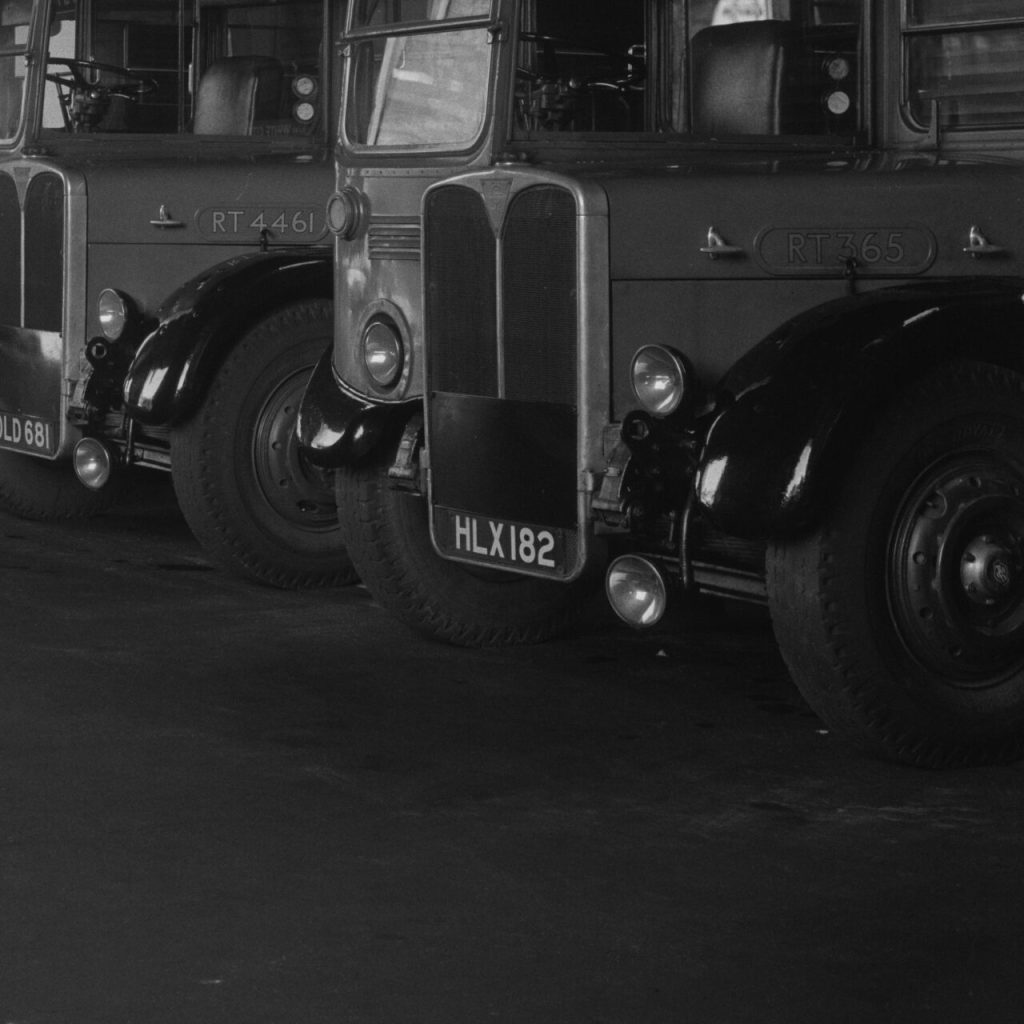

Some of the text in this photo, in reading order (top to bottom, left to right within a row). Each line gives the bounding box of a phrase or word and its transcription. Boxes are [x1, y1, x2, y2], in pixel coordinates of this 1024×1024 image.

[212, 211, 314, 233] RT 4461
[787, 232, 904, 264] RT 365
